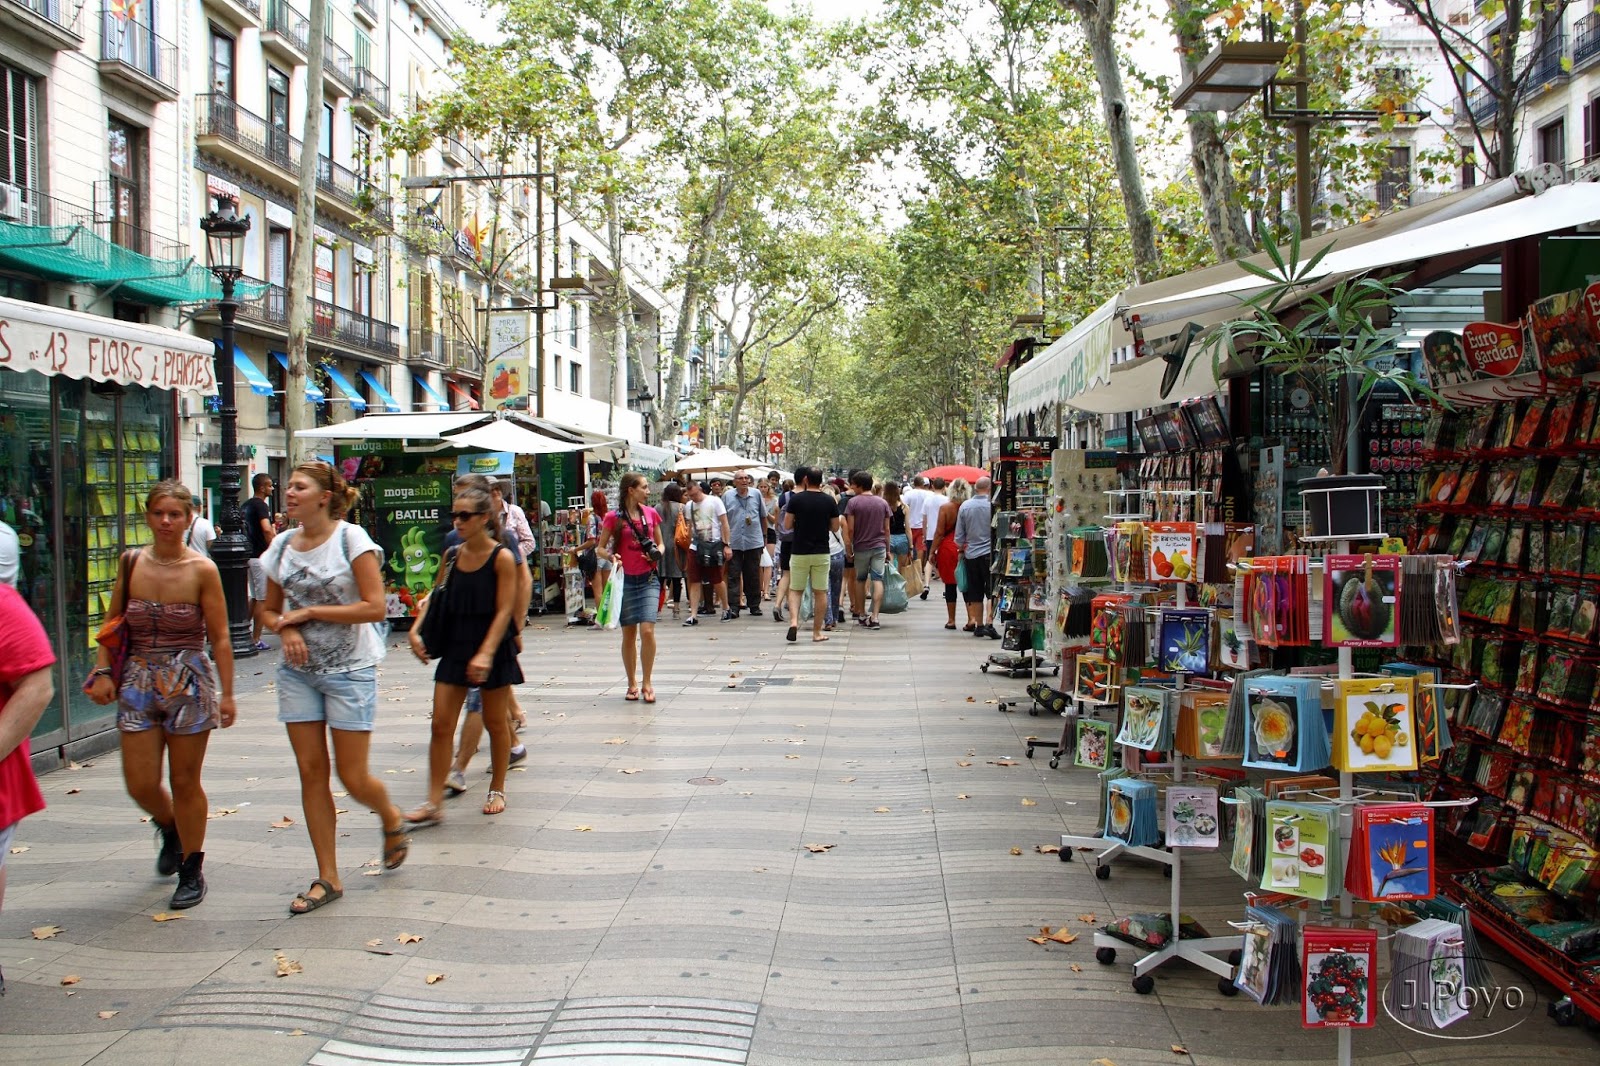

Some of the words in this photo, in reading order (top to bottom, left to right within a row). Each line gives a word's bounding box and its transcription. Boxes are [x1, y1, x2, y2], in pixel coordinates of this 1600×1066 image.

[498, 318, 517, 327] MIRA
[1465, 330, 1499, 350] Euro
[44, 331, 68, 372] 13
[88, 337, 142, 382] FLORS
[163, 350, 213, 389] PLANTES
[1474, 344, 1519, 370] garden
[351, 440, 404, 453] moyasho
[384, 483, 440, 499] moyashop
[395, 509, 439, 520] BATLLE
